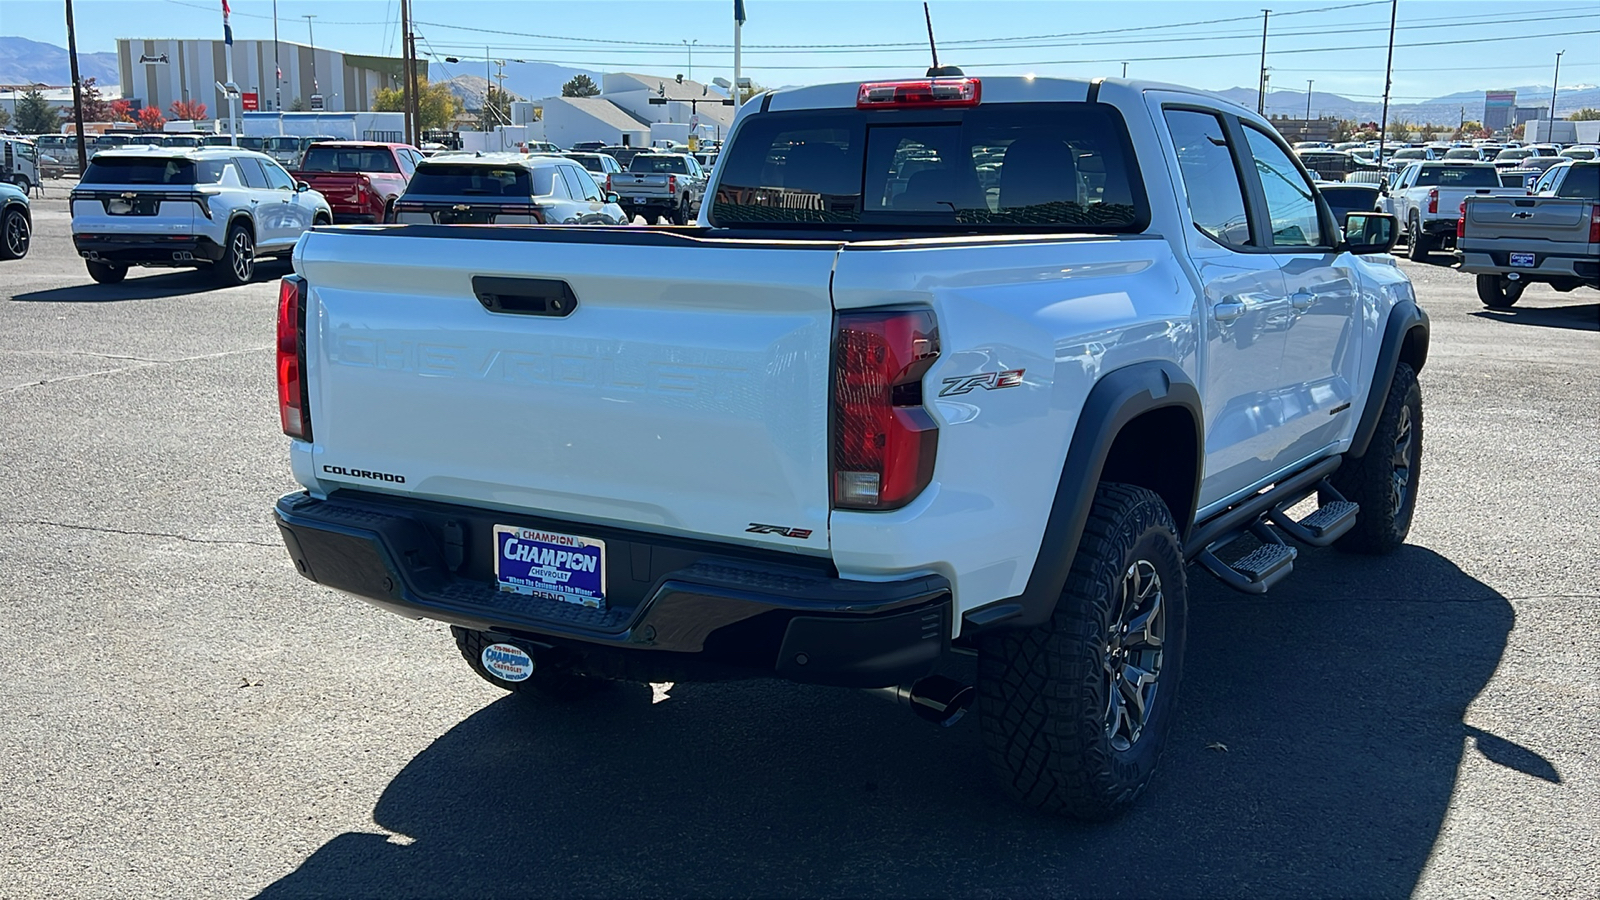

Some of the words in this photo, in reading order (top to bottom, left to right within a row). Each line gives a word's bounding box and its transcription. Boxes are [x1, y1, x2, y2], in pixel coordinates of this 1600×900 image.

[938, 368, 1025, 397] ZR2
[323, 465, 405, 483] COLORADO
[522, 530, 574, 545] CHAMPION
[745, 522, 813, 539] ZR2
[503, 537, 597, 573] CHAMPION
[531, 567, 568, 580] CHEVROLET
[534, 580, 558, 591] Customer
[493, 662, 522, 674] CHEVROLET
